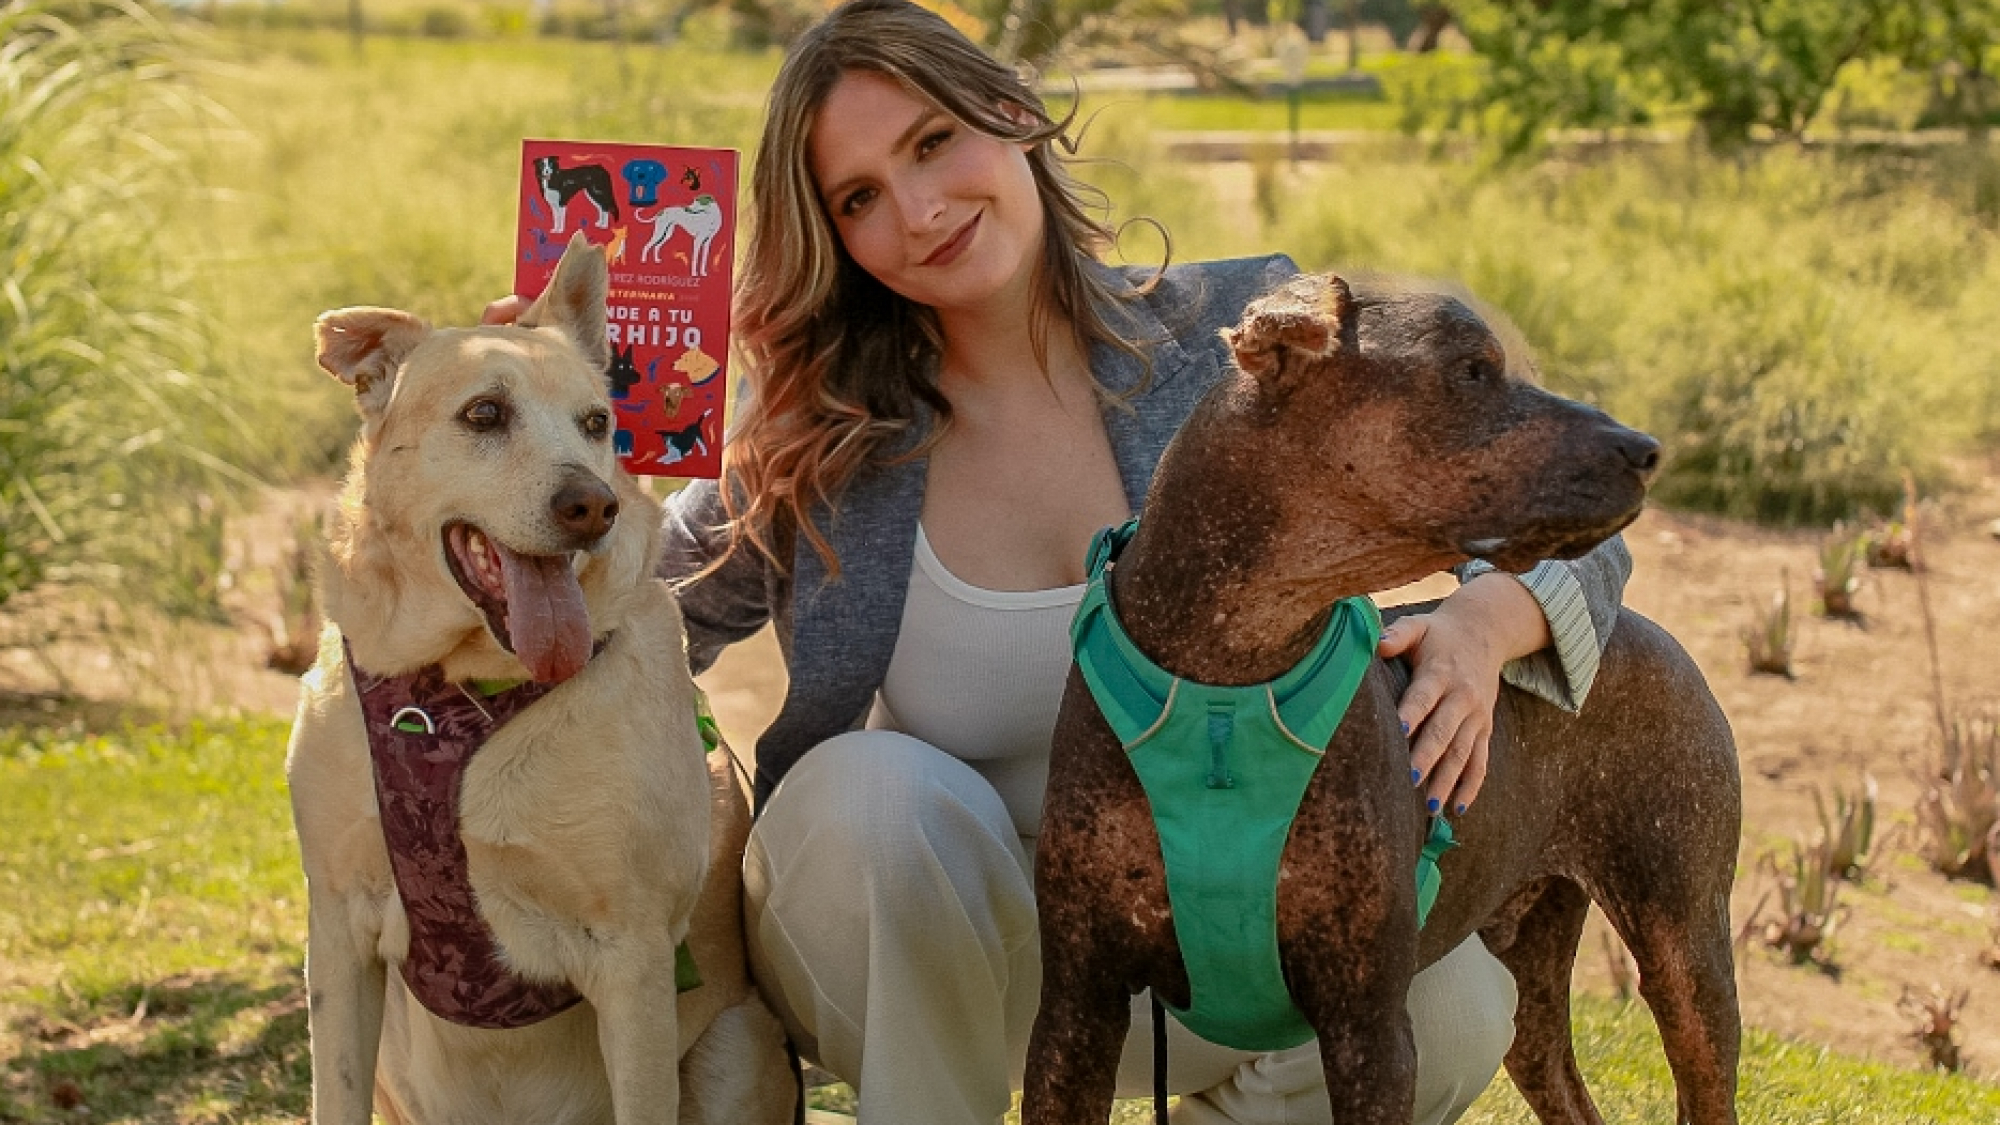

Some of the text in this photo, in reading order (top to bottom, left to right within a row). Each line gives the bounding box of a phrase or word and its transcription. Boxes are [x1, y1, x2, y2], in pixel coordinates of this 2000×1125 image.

[608, 273, 635, 283] REZ
[609, 290, 675, 300] ETERINARIA
[606, 305, 693, 323] NDE A TU
[606, 322, 701, 348] RHIJO
